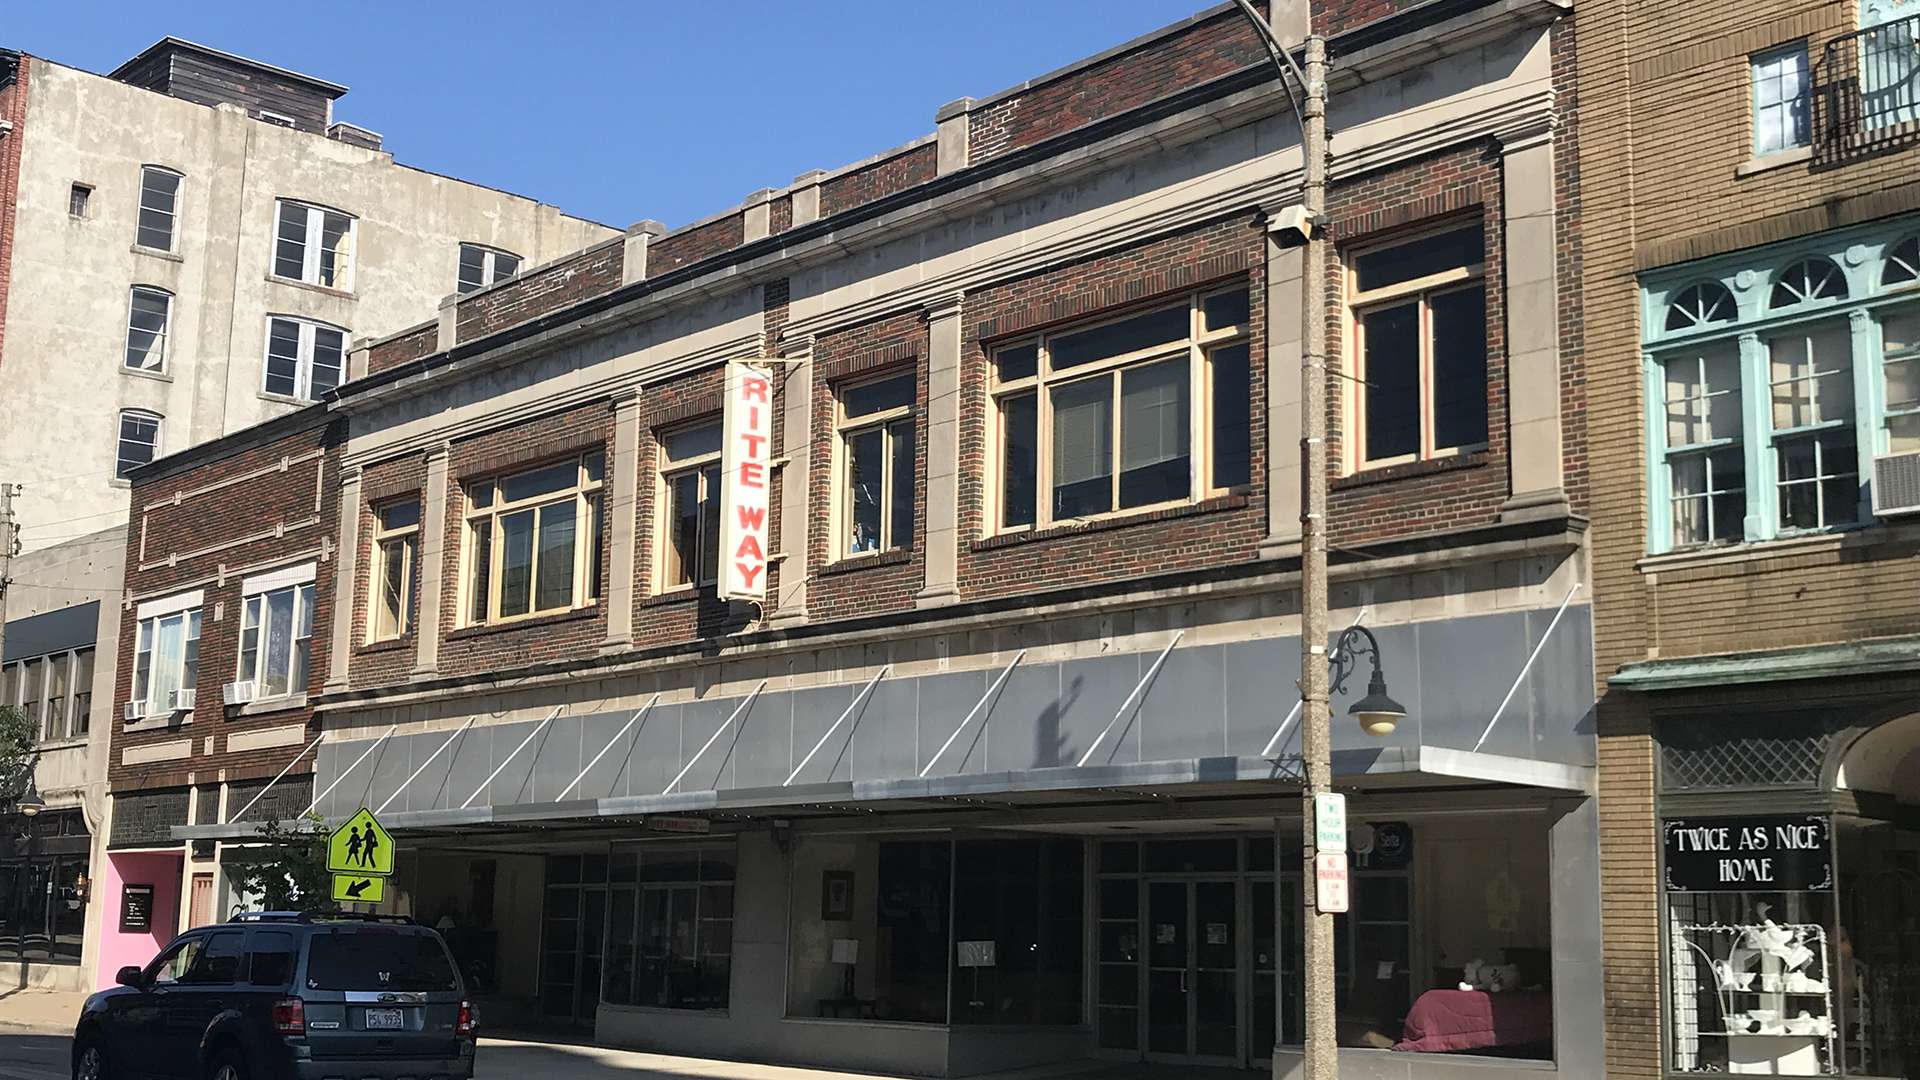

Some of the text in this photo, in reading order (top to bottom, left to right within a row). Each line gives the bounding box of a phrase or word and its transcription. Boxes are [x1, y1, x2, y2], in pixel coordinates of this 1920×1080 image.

[735, 376, 769, 589] RITE WAY
[1319, 832, 1344, 842] PARKING
[1673, 824, 1820, 851] TWICE AS NICE
[1318, 870, 1345, 880] PARKING
[1719, 858, 1774, 882] HOME
